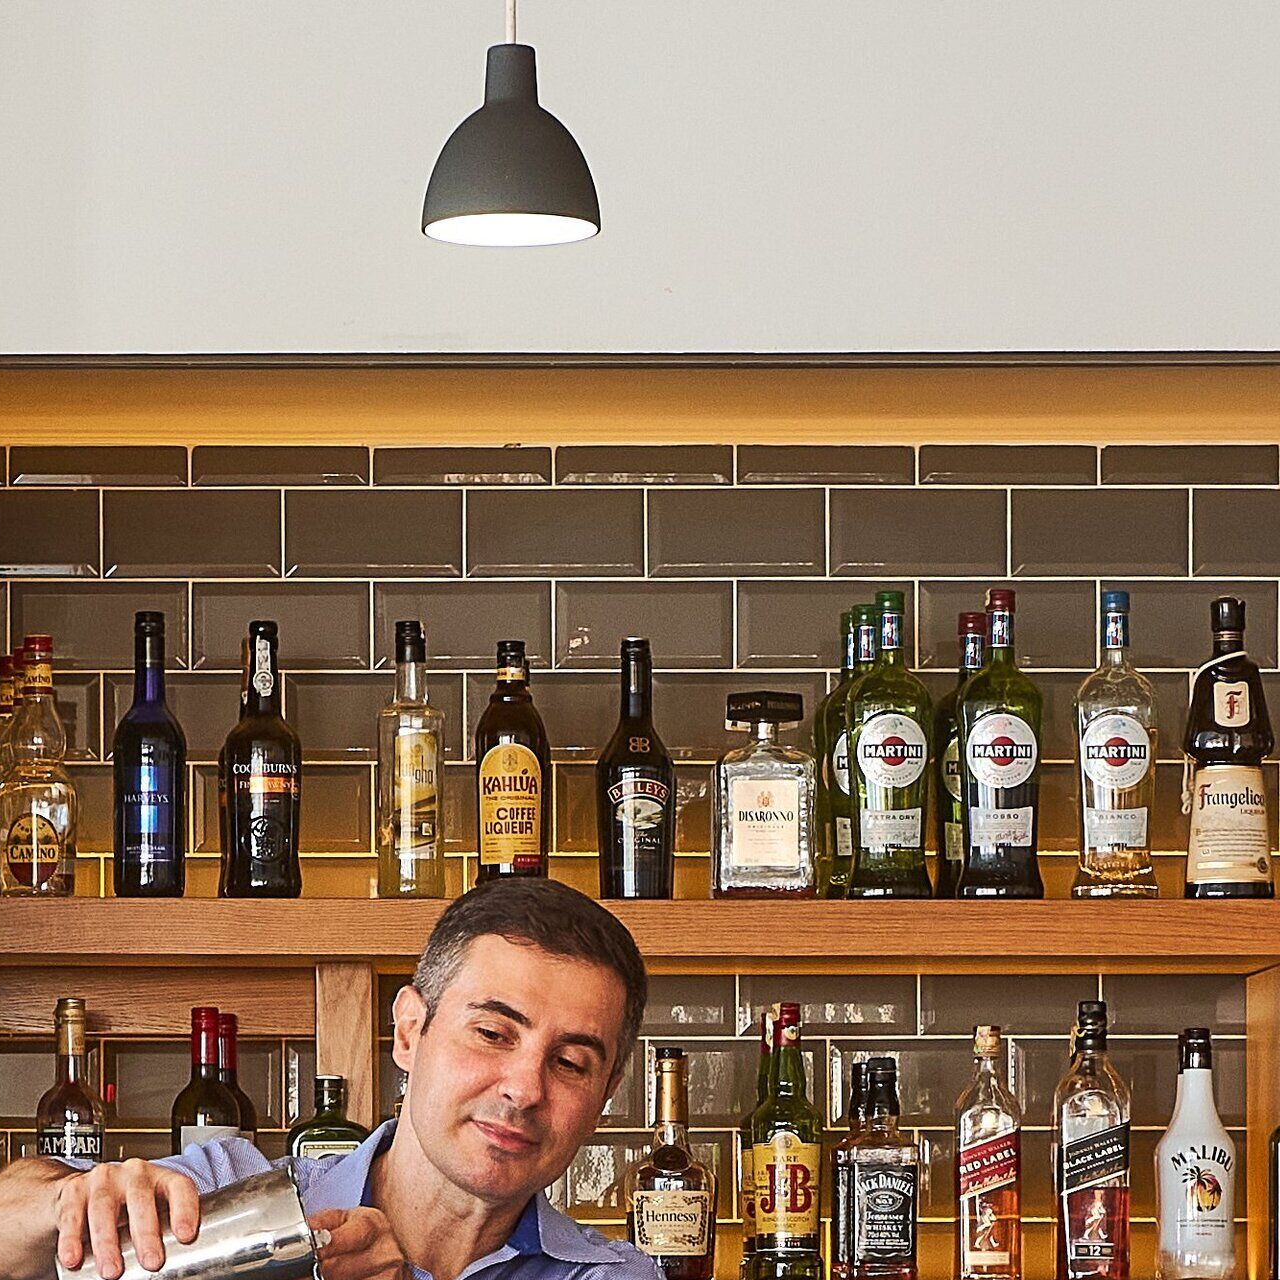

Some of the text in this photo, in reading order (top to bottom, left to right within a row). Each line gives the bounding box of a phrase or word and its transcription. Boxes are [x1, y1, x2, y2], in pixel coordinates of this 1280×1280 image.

[865, 745, 922, 758] MARTINI
[974, 745, 1031, 758] MARTINI
[1088, 746, 1145, 759] MARTINI
[483, 768, 539, 795] KAHLÚA
[612, 782, 667, 799] BLEYS
[1199, 783, 1266, 811] Frangelico
[496, 807, 536, 821] COFFEE
[738, 810, 794, 822] DISARONNO
[485, 821, 533, 835] LIQUEUR
[960, 1148, 1017, 1175] RED LABEL
[1063, 1153, 1094, 1170] BLACK
[1094, 1143, 1125, 1159] LABEL
[1171, 1145, 1233, 1173] MALIBU
[646, 1210, 699, 1225] Hennessy
[865, 1224, 903, 1232] WHISKEY
[1088, 1245, 1102, 1256] 12
